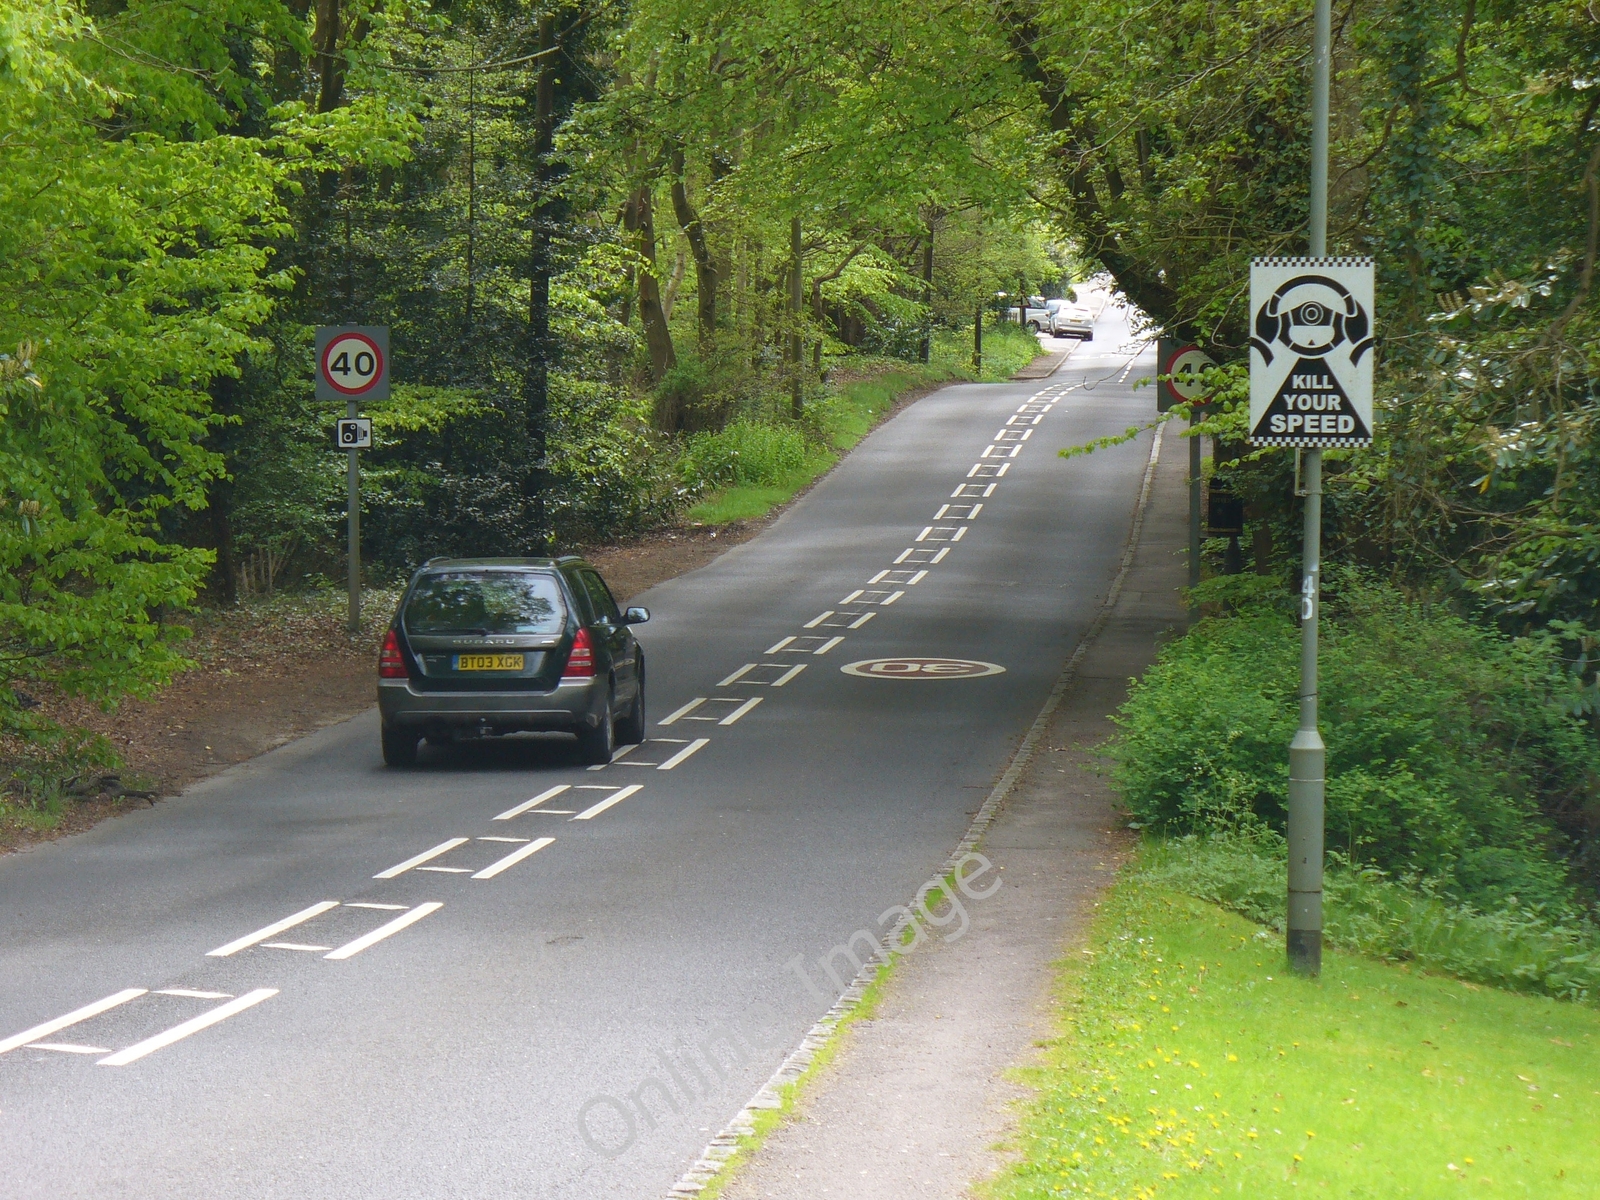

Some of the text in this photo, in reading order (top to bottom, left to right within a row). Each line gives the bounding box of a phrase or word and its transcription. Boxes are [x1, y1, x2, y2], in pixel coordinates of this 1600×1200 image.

[331, 351, 375, 376] 40
[1292, 374, 1334, 390] KILL
[1283, 394, 1342, 411] YOUR
[1270, 414, 1355, 433] SPEED
[460, 656, 493, 669] BT03
[496, 656, 522, 669] XGK
